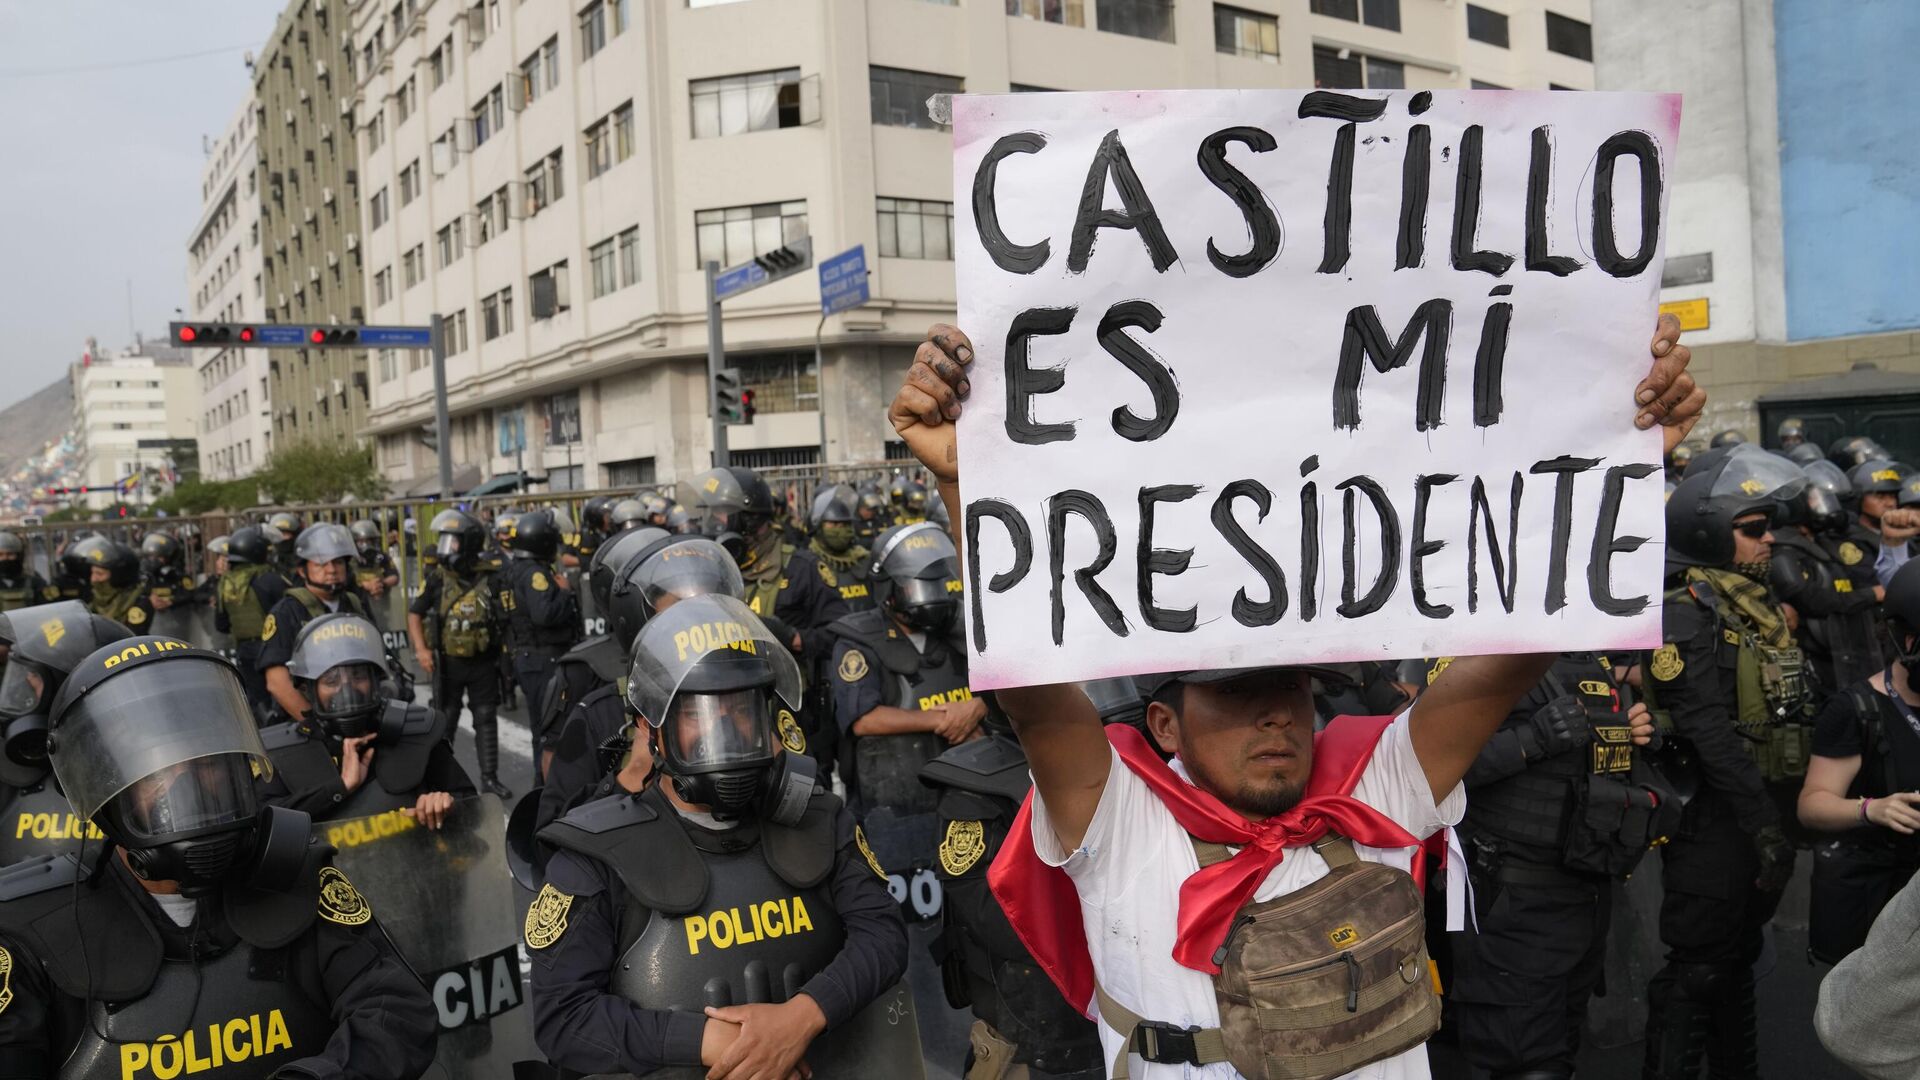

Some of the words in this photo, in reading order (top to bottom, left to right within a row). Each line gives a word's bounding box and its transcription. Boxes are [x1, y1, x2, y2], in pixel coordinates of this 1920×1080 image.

[1004, 299, 1181, 445] ES
[313, 622, 369, 645] POLICIA
[382, 632, 408, 650] CIA
[674, 621, 757, 662] POLICIA
[919, 687, 973, 711] POLICIA
[327, 806, 416, 849] POLICIA
[684, 896, 814, 956] POLICIA
[1332, 928, 1352, 943] CAT
[433, 955, 518, 1028] CIA
[120, 1008, 293, 1080] POLICIA
